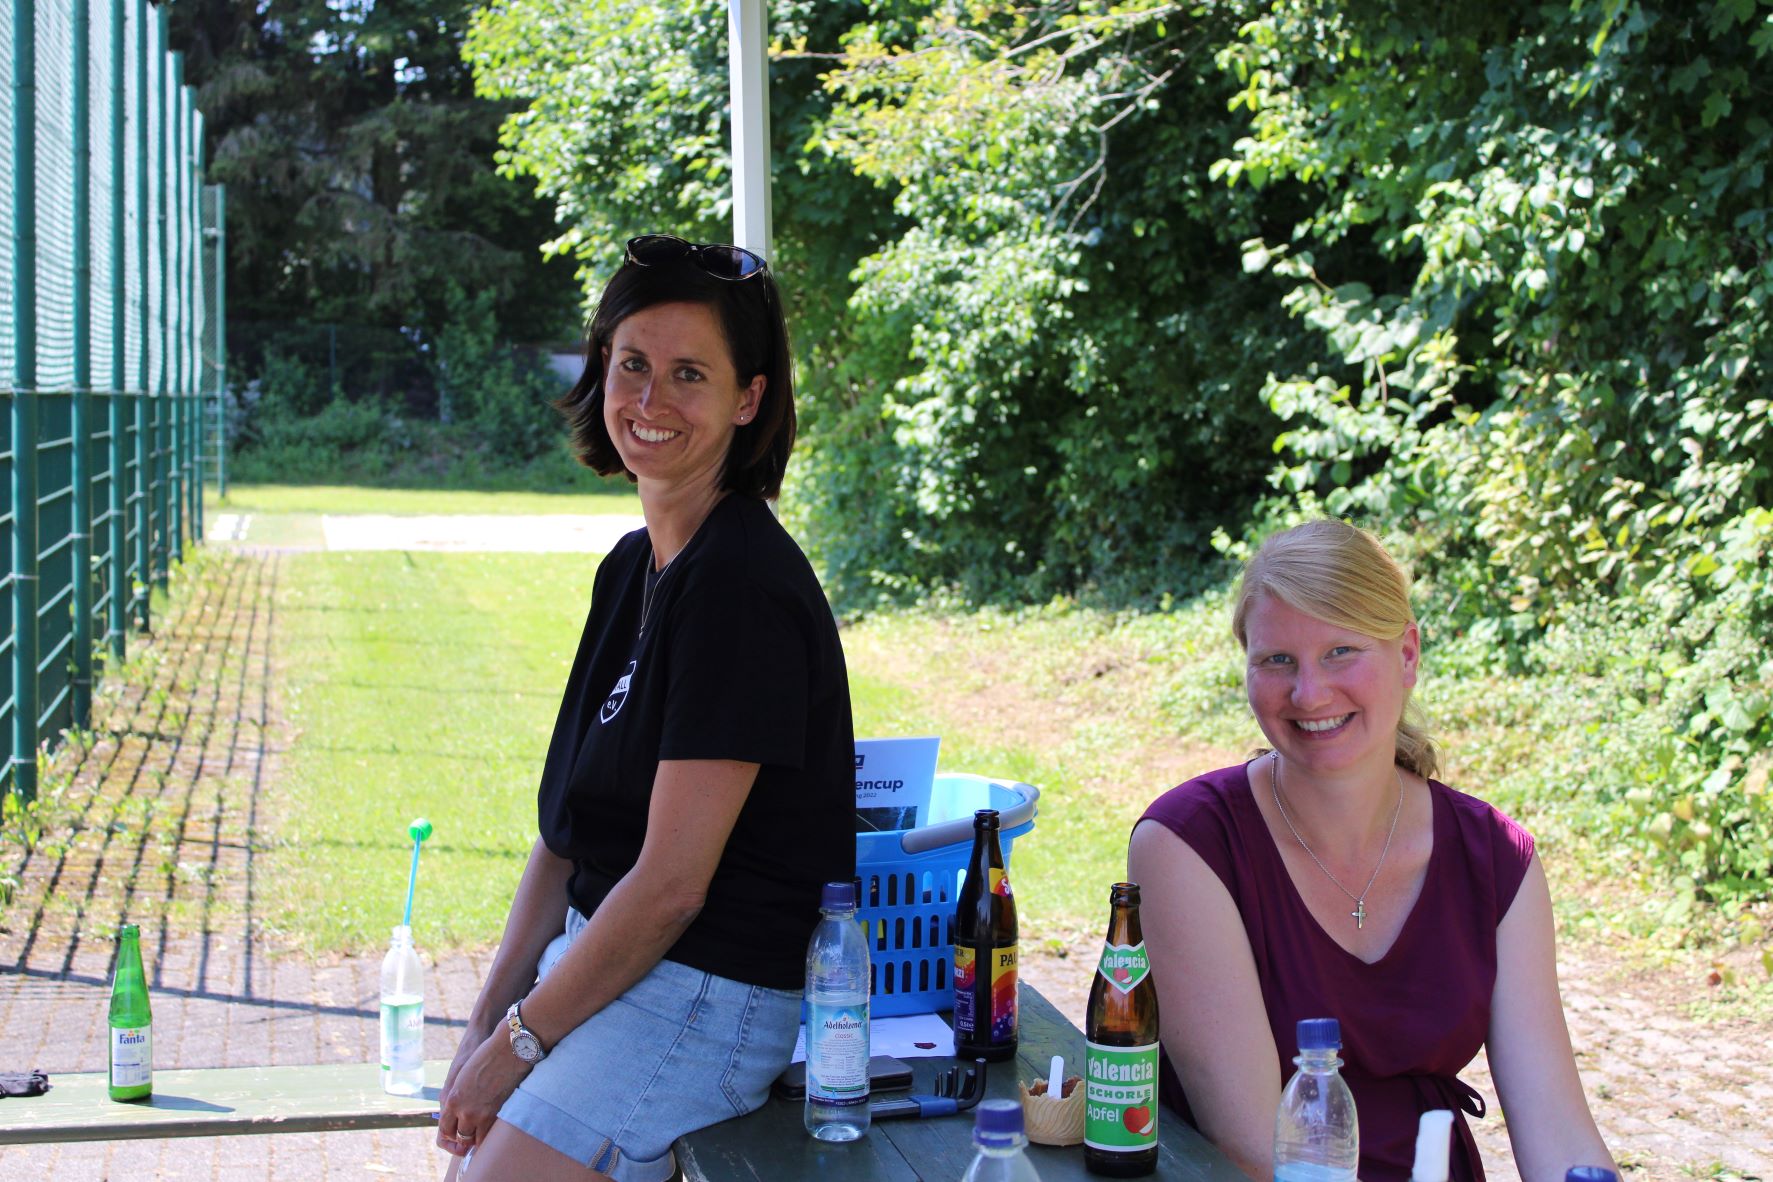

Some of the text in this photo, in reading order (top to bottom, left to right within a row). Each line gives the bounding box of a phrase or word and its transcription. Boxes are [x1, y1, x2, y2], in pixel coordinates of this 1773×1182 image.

[1103, 953, 1146, 969] Valencia
[119, 1033, 145, 1044] Fanta
[1088, 1056, 1153, 1082] Valencia
[1089, 1086, 1151, 1099] SCHORLE
[1087, 1103, 1119, 1122] Apfel
